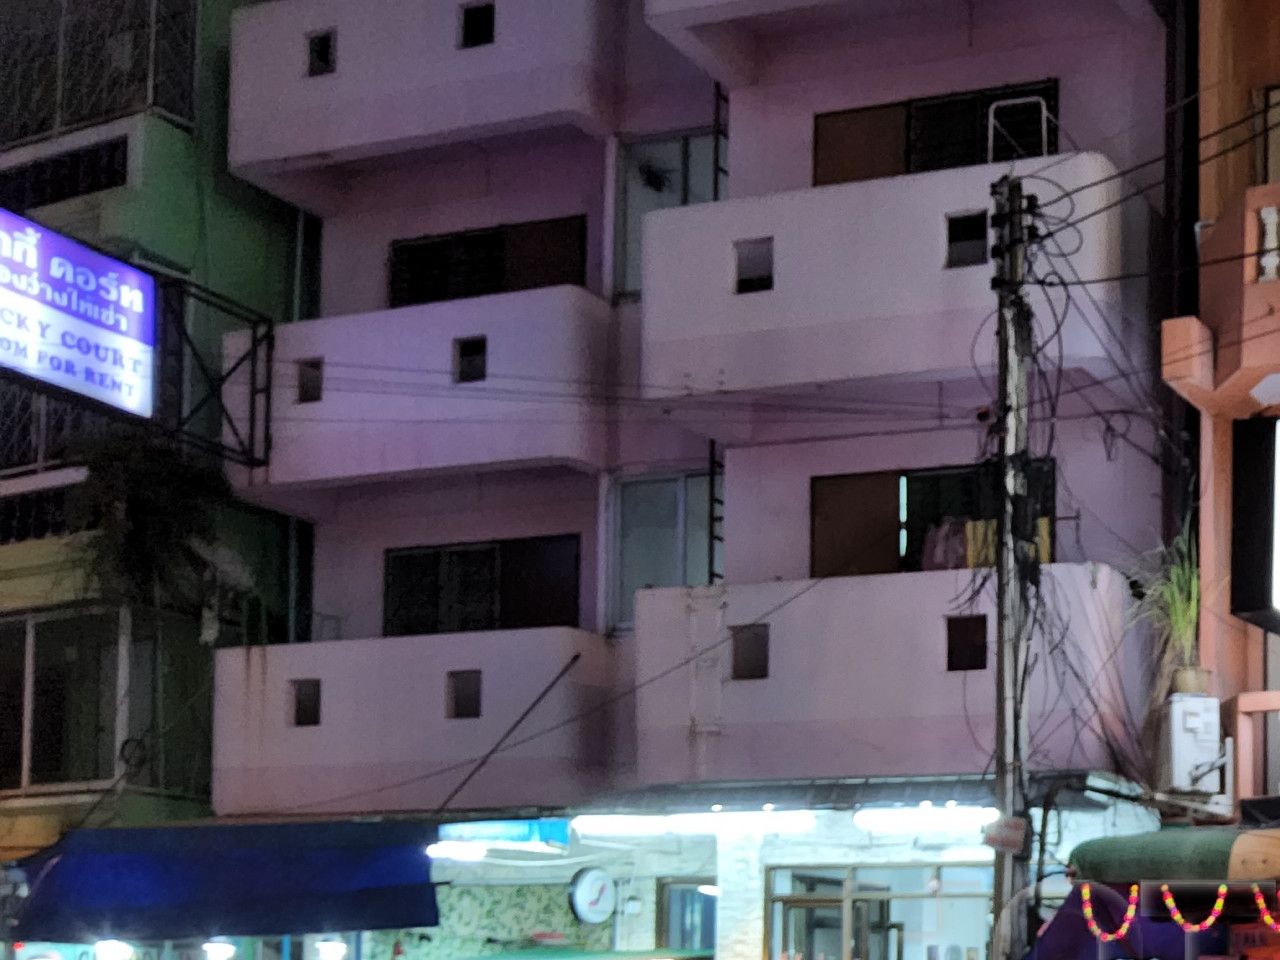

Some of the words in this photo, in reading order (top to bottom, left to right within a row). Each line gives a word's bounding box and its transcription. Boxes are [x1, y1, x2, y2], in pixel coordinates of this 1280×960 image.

[37, 349, 77, 377] FOR
[84, 366, 134, 397] RENT
[61, 330, 141, 374] COURT
